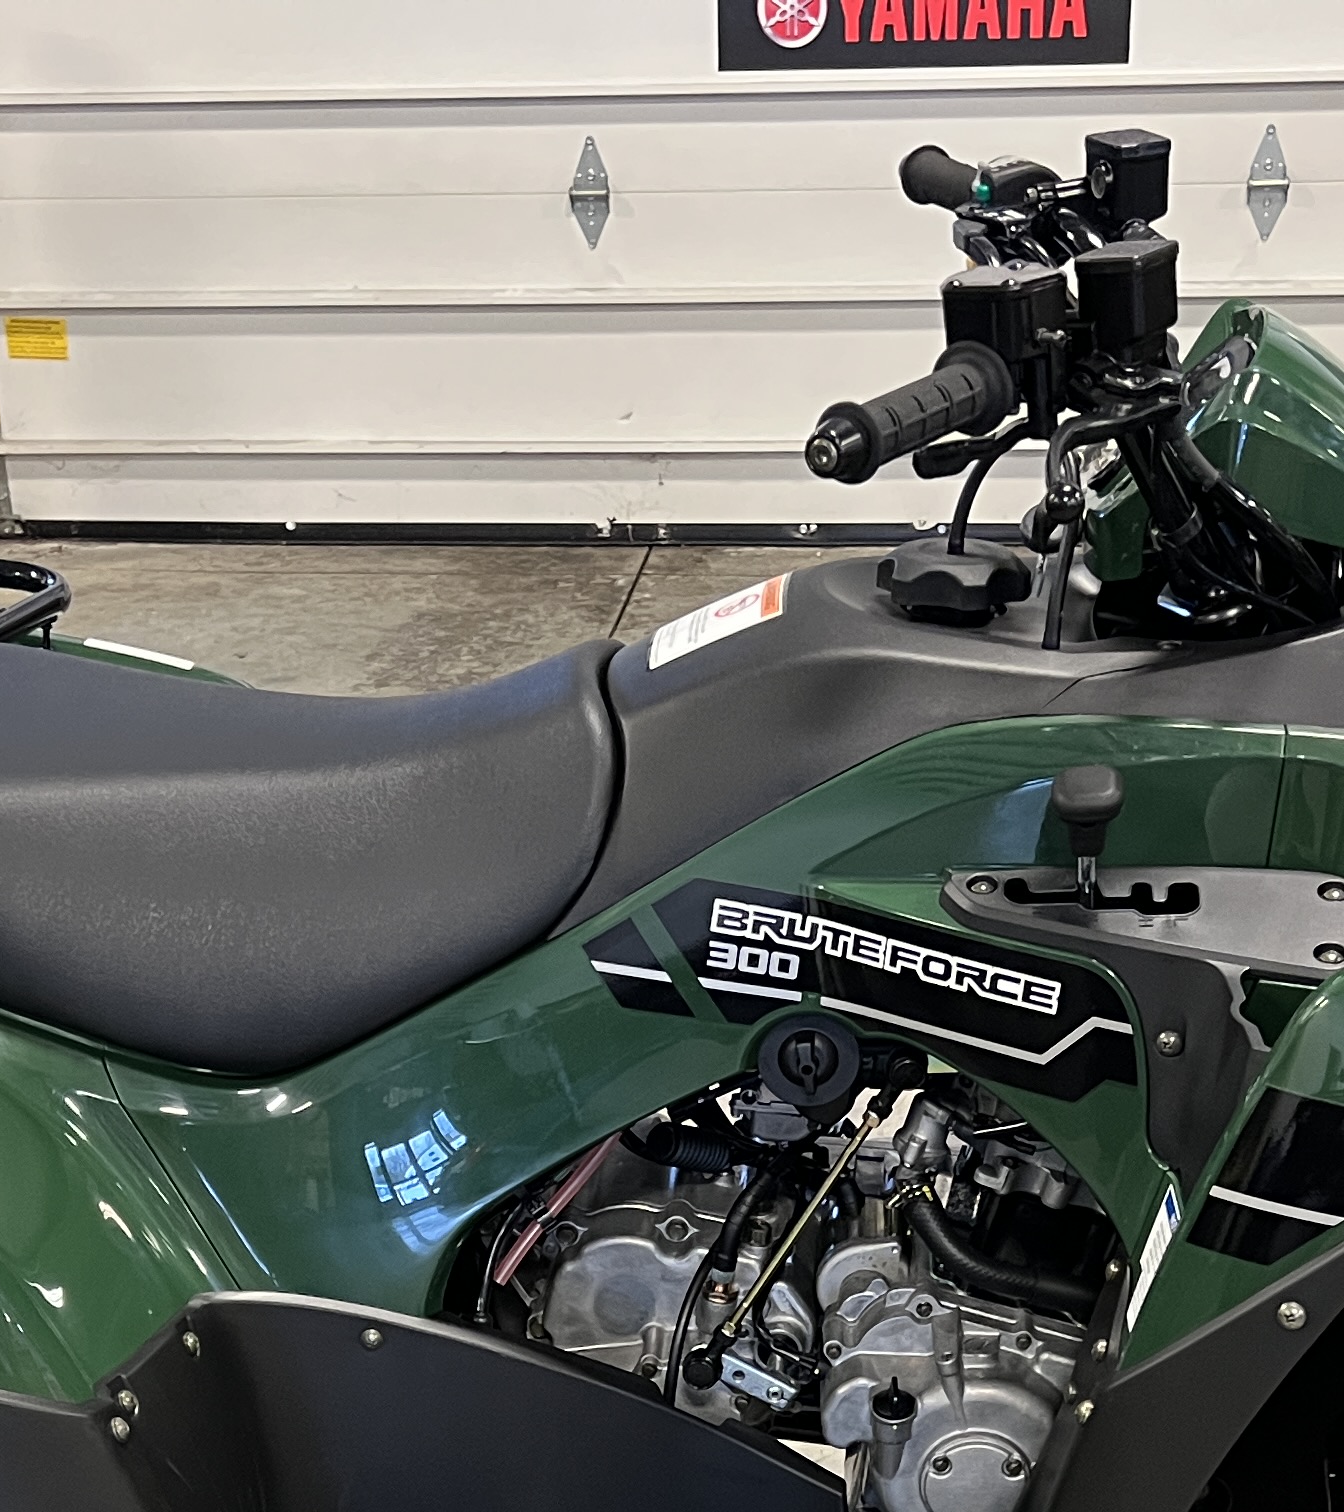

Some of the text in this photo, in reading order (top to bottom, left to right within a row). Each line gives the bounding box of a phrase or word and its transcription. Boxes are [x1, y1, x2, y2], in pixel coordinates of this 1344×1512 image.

[840, 0, 1088, 43] YAMAHA
[707, 940, 801, 980] 300
[709, 897, 1061, 1015] BRUTE FORCE
